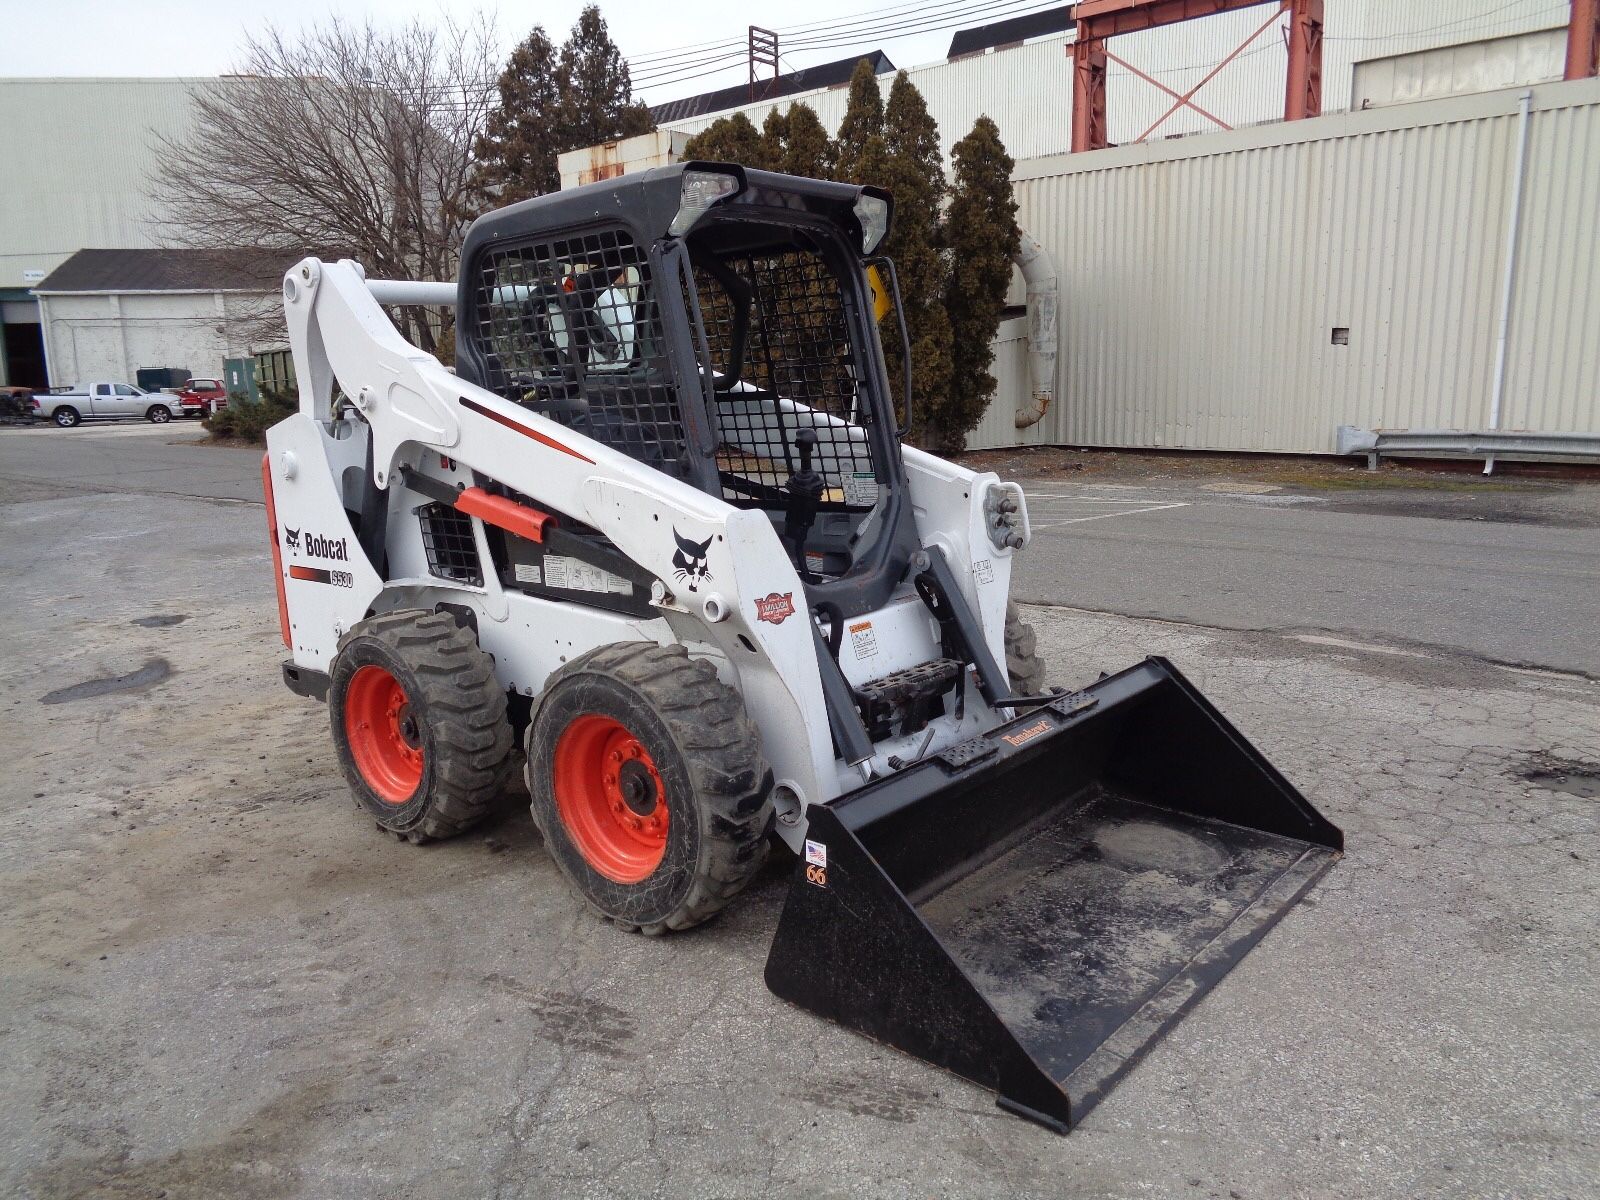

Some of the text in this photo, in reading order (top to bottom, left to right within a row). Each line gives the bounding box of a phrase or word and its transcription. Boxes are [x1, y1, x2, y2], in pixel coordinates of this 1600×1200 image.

[305, 532, 348, 561] Bobcat
[332, 570, 353, 588] S530
[1001, 720, 1051, 746] Tomahawk
[807, 865, 825, 884] 66
